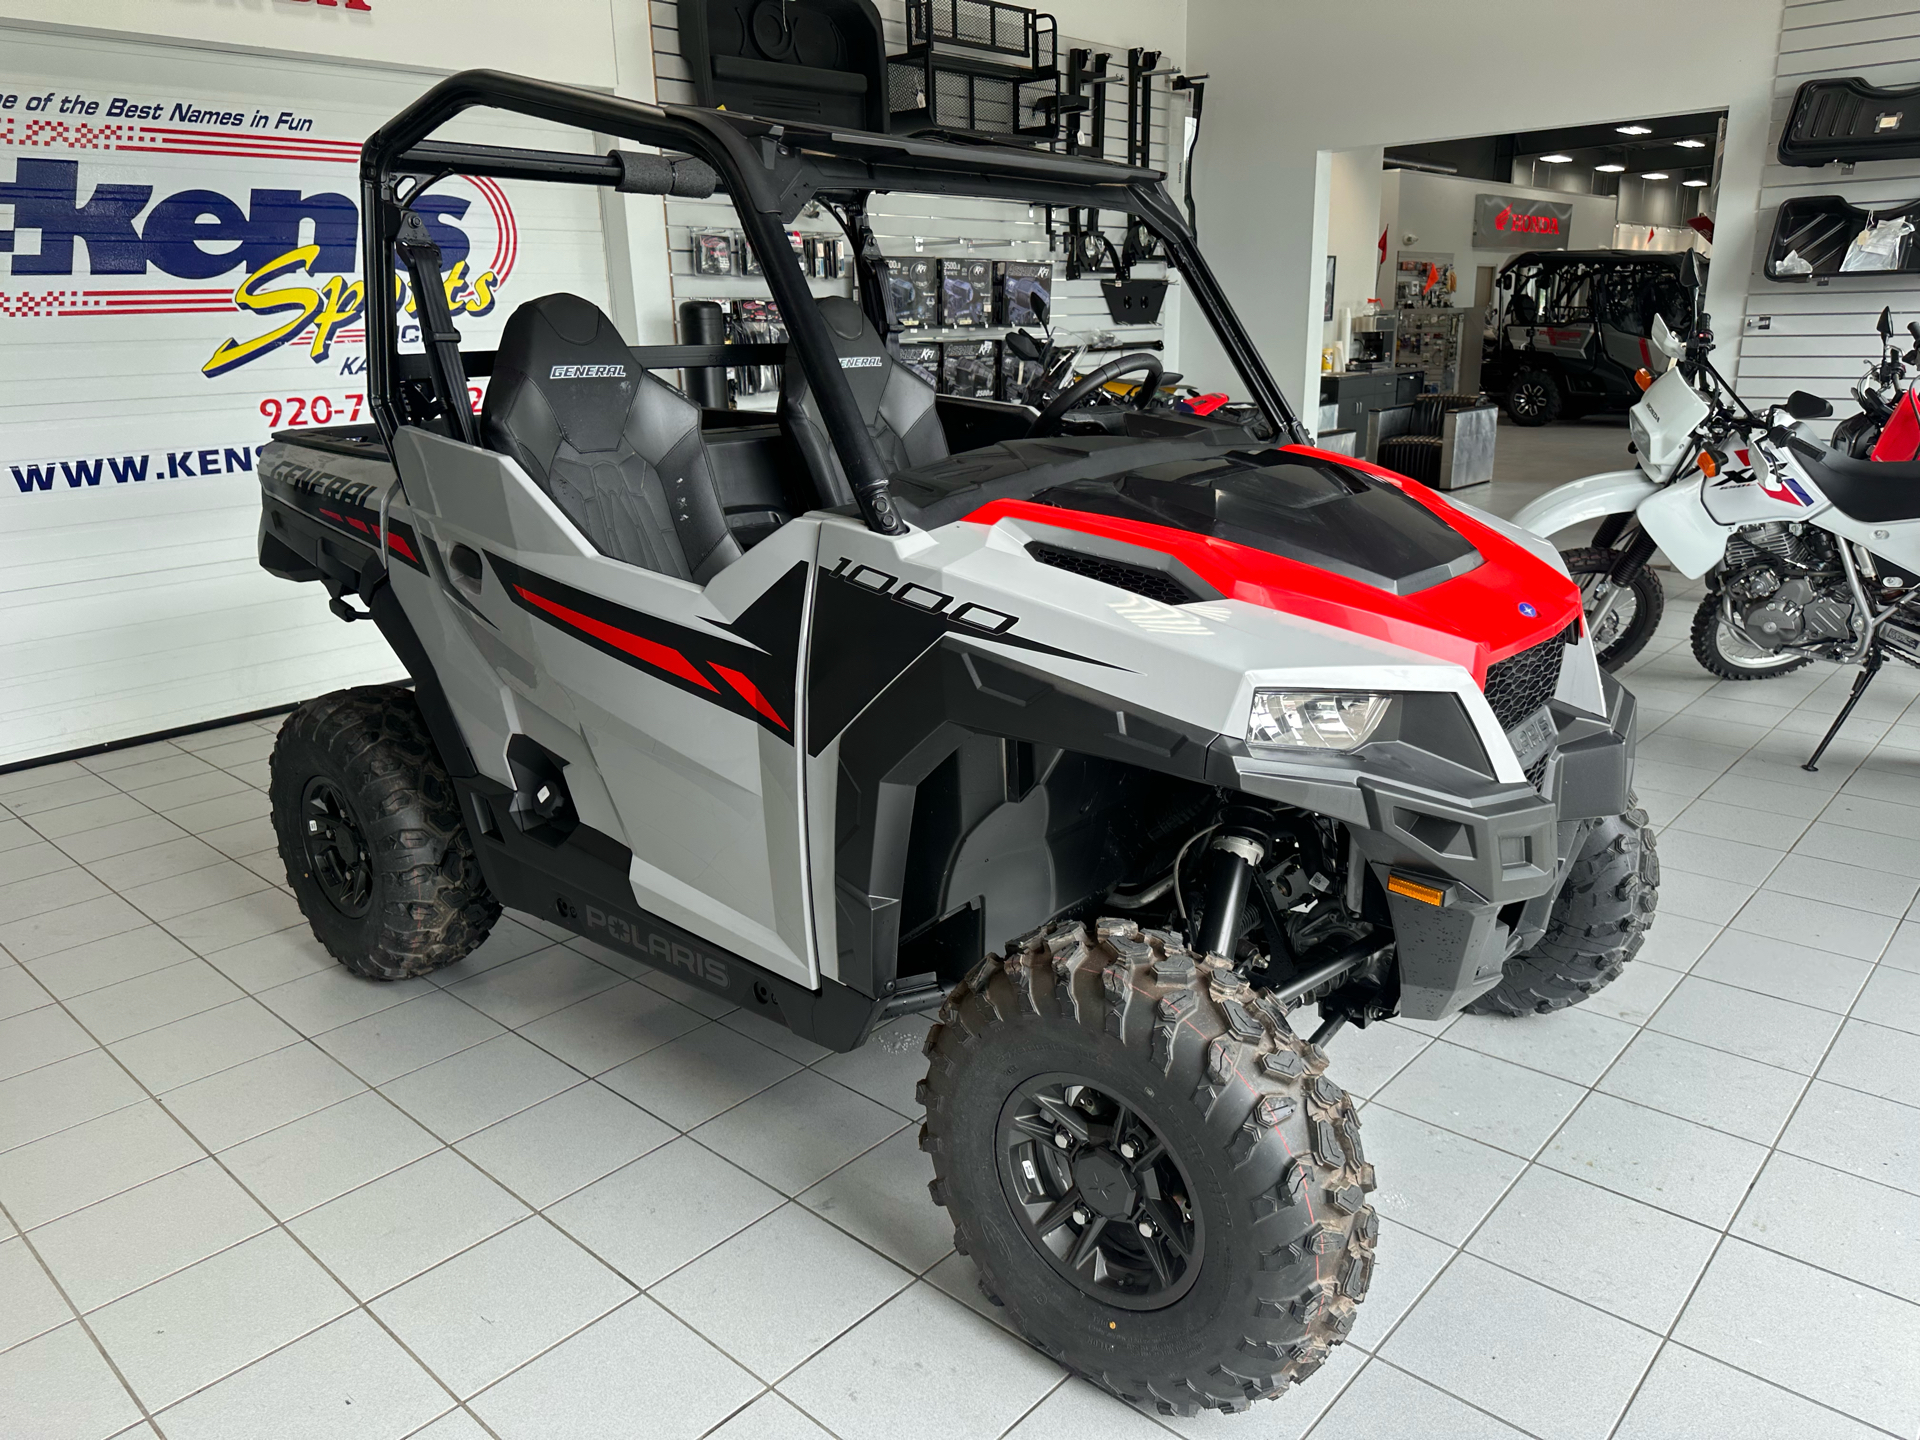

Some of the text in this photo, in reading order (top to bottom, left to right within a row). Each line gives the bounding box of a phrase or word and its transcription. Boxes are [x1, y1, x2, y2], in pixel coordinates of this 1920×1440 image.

[0, 92, 313, 132] e of the Best Names in Fun
[1510, 213, 1560, 235] HONDA
[549, 365, 627, 380] GENERAL
[838, 356, 882, 369] ENERAL
[1646, 402, 1660, 423] HONDA
[270, 460, 378, 508] GENERAL
[828, 556, 1020, 636] 1000
[1510, 714, 1552, 758] LARIS
[585, 904, 731, 990] POLARIS
